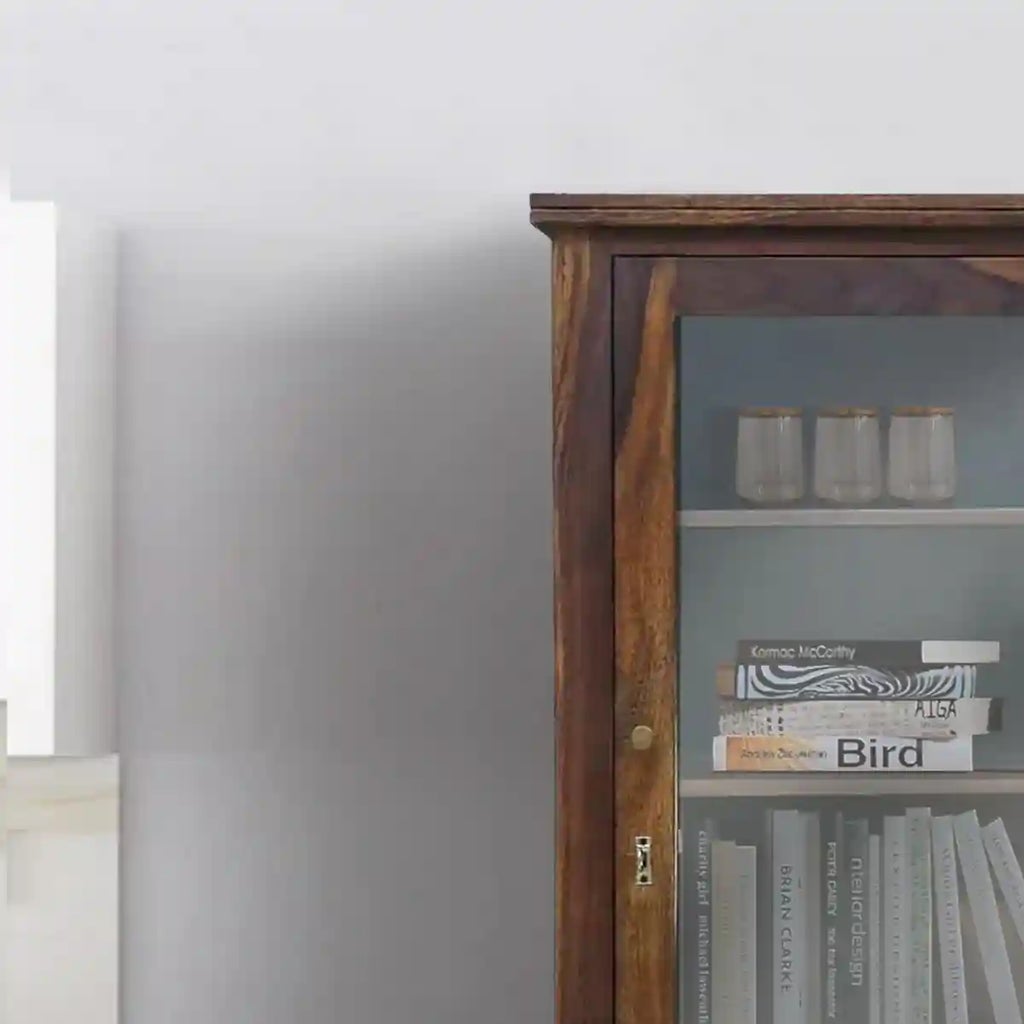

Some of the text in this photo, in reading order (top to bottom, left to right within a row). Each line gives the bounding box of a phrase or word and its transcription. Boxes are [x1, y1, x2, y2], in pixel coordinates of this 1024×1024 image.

[797, 643, 857, 663] McCarthy
[914, 700, 957, 719] AIGA
[837, 738, 924, 768] Bird
[695, 881, 709, 906] girl
[780, 865, 793, 993] BRIAN CLARKE
